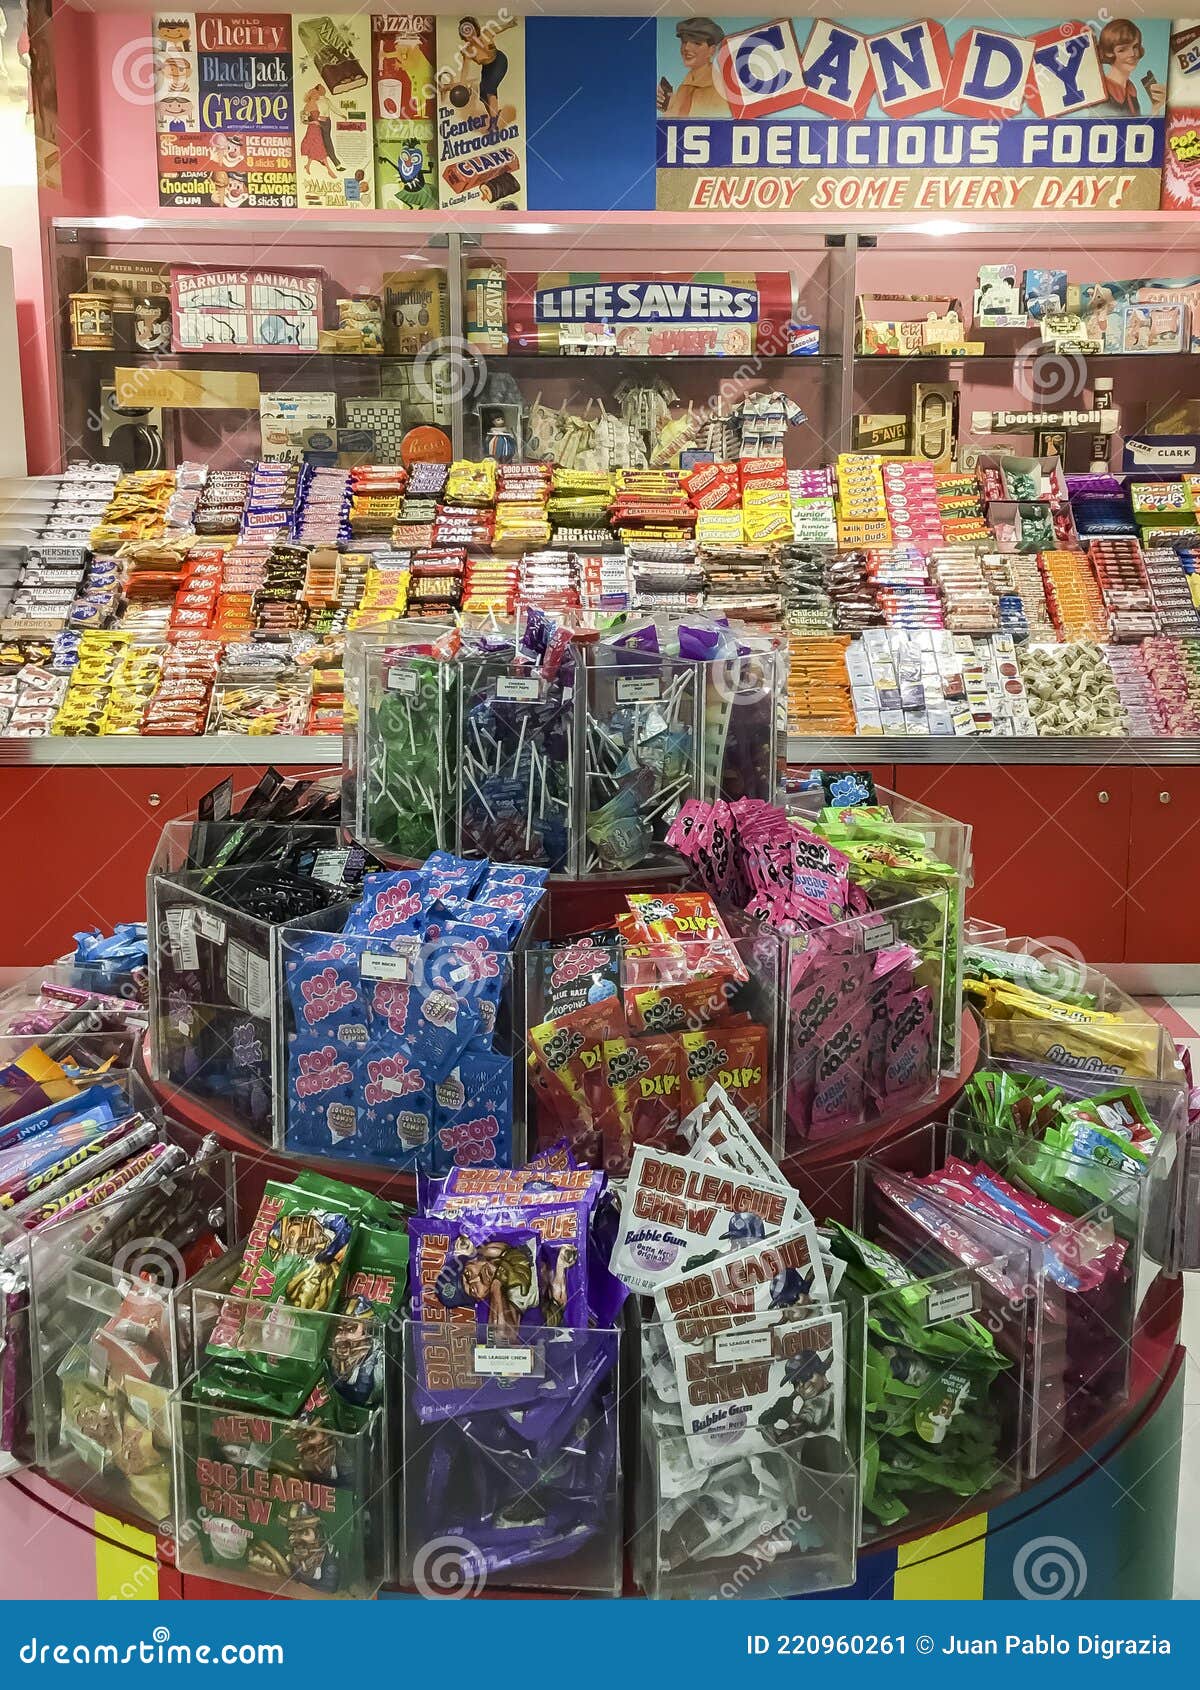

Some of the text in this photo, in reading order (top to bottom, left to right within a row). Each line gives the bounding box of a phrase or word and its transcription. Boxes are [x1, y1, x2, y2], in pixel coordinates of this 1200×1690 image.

[200, 17, 284, 50] Cherry
[372, 14, 434, 33] Fizzies
[319, 21, 351, 59] MARS
[736, 22, 1091, 107] CANDY
[202, 92, 288, 129] Grape
[439, 106, 455, 119] The
[440, 114, 489, 139] Center
[160, 141, 216, 157] Strawberry
[246, 136, 292, 146] ICE CREAM
[440, 125, 520, 161] Attraction
[667, 124, 1155, 164] IS DELICIOUS FOOD
[1169, 130, 1197, 150] POP
[174, 157, 198, 165] GUM
[246, 147, 292, 157] FLAVORS
[246, 157, 275, 167] 8 sticks
[458, 147, 513, 176] CLARK
[160, 178, 216, 194] Chocolate
[247, 172, 296, 184] ICE CREAM
[247, 184, 296, 195] FLAVORS
[174, 196, 202, 205] GUM
[248, 195, 279, 206] 8 sticks
[689, 175, 1137, 209] ENJOY SOME EVERY DAY!
[110, 264, 154, 273] PETER PAUL
[178, 272, 319, 294] BARNUM'S ANIMALS
[543, 284, 757, 319] LIFE SAVERS
[995, 410, 1101, 427] Tootsie Roll
[263, 449, 299, 464] milky
[1157, 449, 1191, 458] CLARK
[502, 464, 540, 474] GOOD NEWS
[794, 510, 825, 518] Junior
[938, 501, 976, 510] Crows
[249, 513, 286, 525] CRUNCH
[864, 522, 886, 531] Duds
[437, 527, 473, 535] CLARK
[579, 533, 614, 541] HUNK
[796, 530, 829, 538] Junior
[843, 532, 887, 543] Milk Duds
[946, 531, 988, 541] Crows
[789, 617, 826, 625] Chuckles
[792, 609, 829, 617] Chuckles
[798, 839, 831, 860] POP
[795, 855, 839, 876] ROCKS
[794, 874, 830, 890] BUBBLE
[803, 887, 828, 900] GUM
[376, 878, 412, 914] POP
[368, 892, 423, 934] ROCKS
[673, 915, 720, 932] DIPS
[552, 938, 593, 969] POP
[550, 949, 611, 988] ROCKS
[301, 967, 339, 1001] POP
[552, 987, 588, 1001] BLUE RAZZ
[303, 980, 358, 1025] ROCKS
[552, 1000, 588, 1016] POPPING
[644, 996, 672, 1022] POP
[543, 1028, 569, 1055] POP
[547, 1032, 587, 1071] ROCKS
[688, 1039, 717, 1065] POP
[298, 1046, 338, 1075] POP
[367, 1052, 409, 1082] POP
[608, 1047, 639, 1071] POP
[686, 1049, 729, 1081] ROCKS
[295, 1061, 354, 1098] ROCKS
[606, 1056, 651, 1088] ROCKS
[717, 1066, 761, 1090] DIPS
[639, 1073, 681, 1096] DIPS
[18, 1118, 49, 1141] GIANT
[438, 1114, 500, 1152] ROCKS
[453, 1138, 497, 1167] POP
[27, 1144, 104, 1193] Spree
[637, 1157, 788, 1226] BIG LEAGUE
[632, 1188, 722, 1237] CHEW
[230, 1194, 286, 1297] LEAGUE
[624, 1228, 688, 1249] Bubble Gum
[664, 1234, 812, 1314] BIG LEAGUE
[674, 1287, 758, 1344] CHEW
[687, 1363, 772, 1407] CHEW
[691, 1403, 753, 1434] Bubble Gum
[196, 1456, 337, 1513] BIG LEAGUE
[200, 1485, 273, 1526] CHEW
